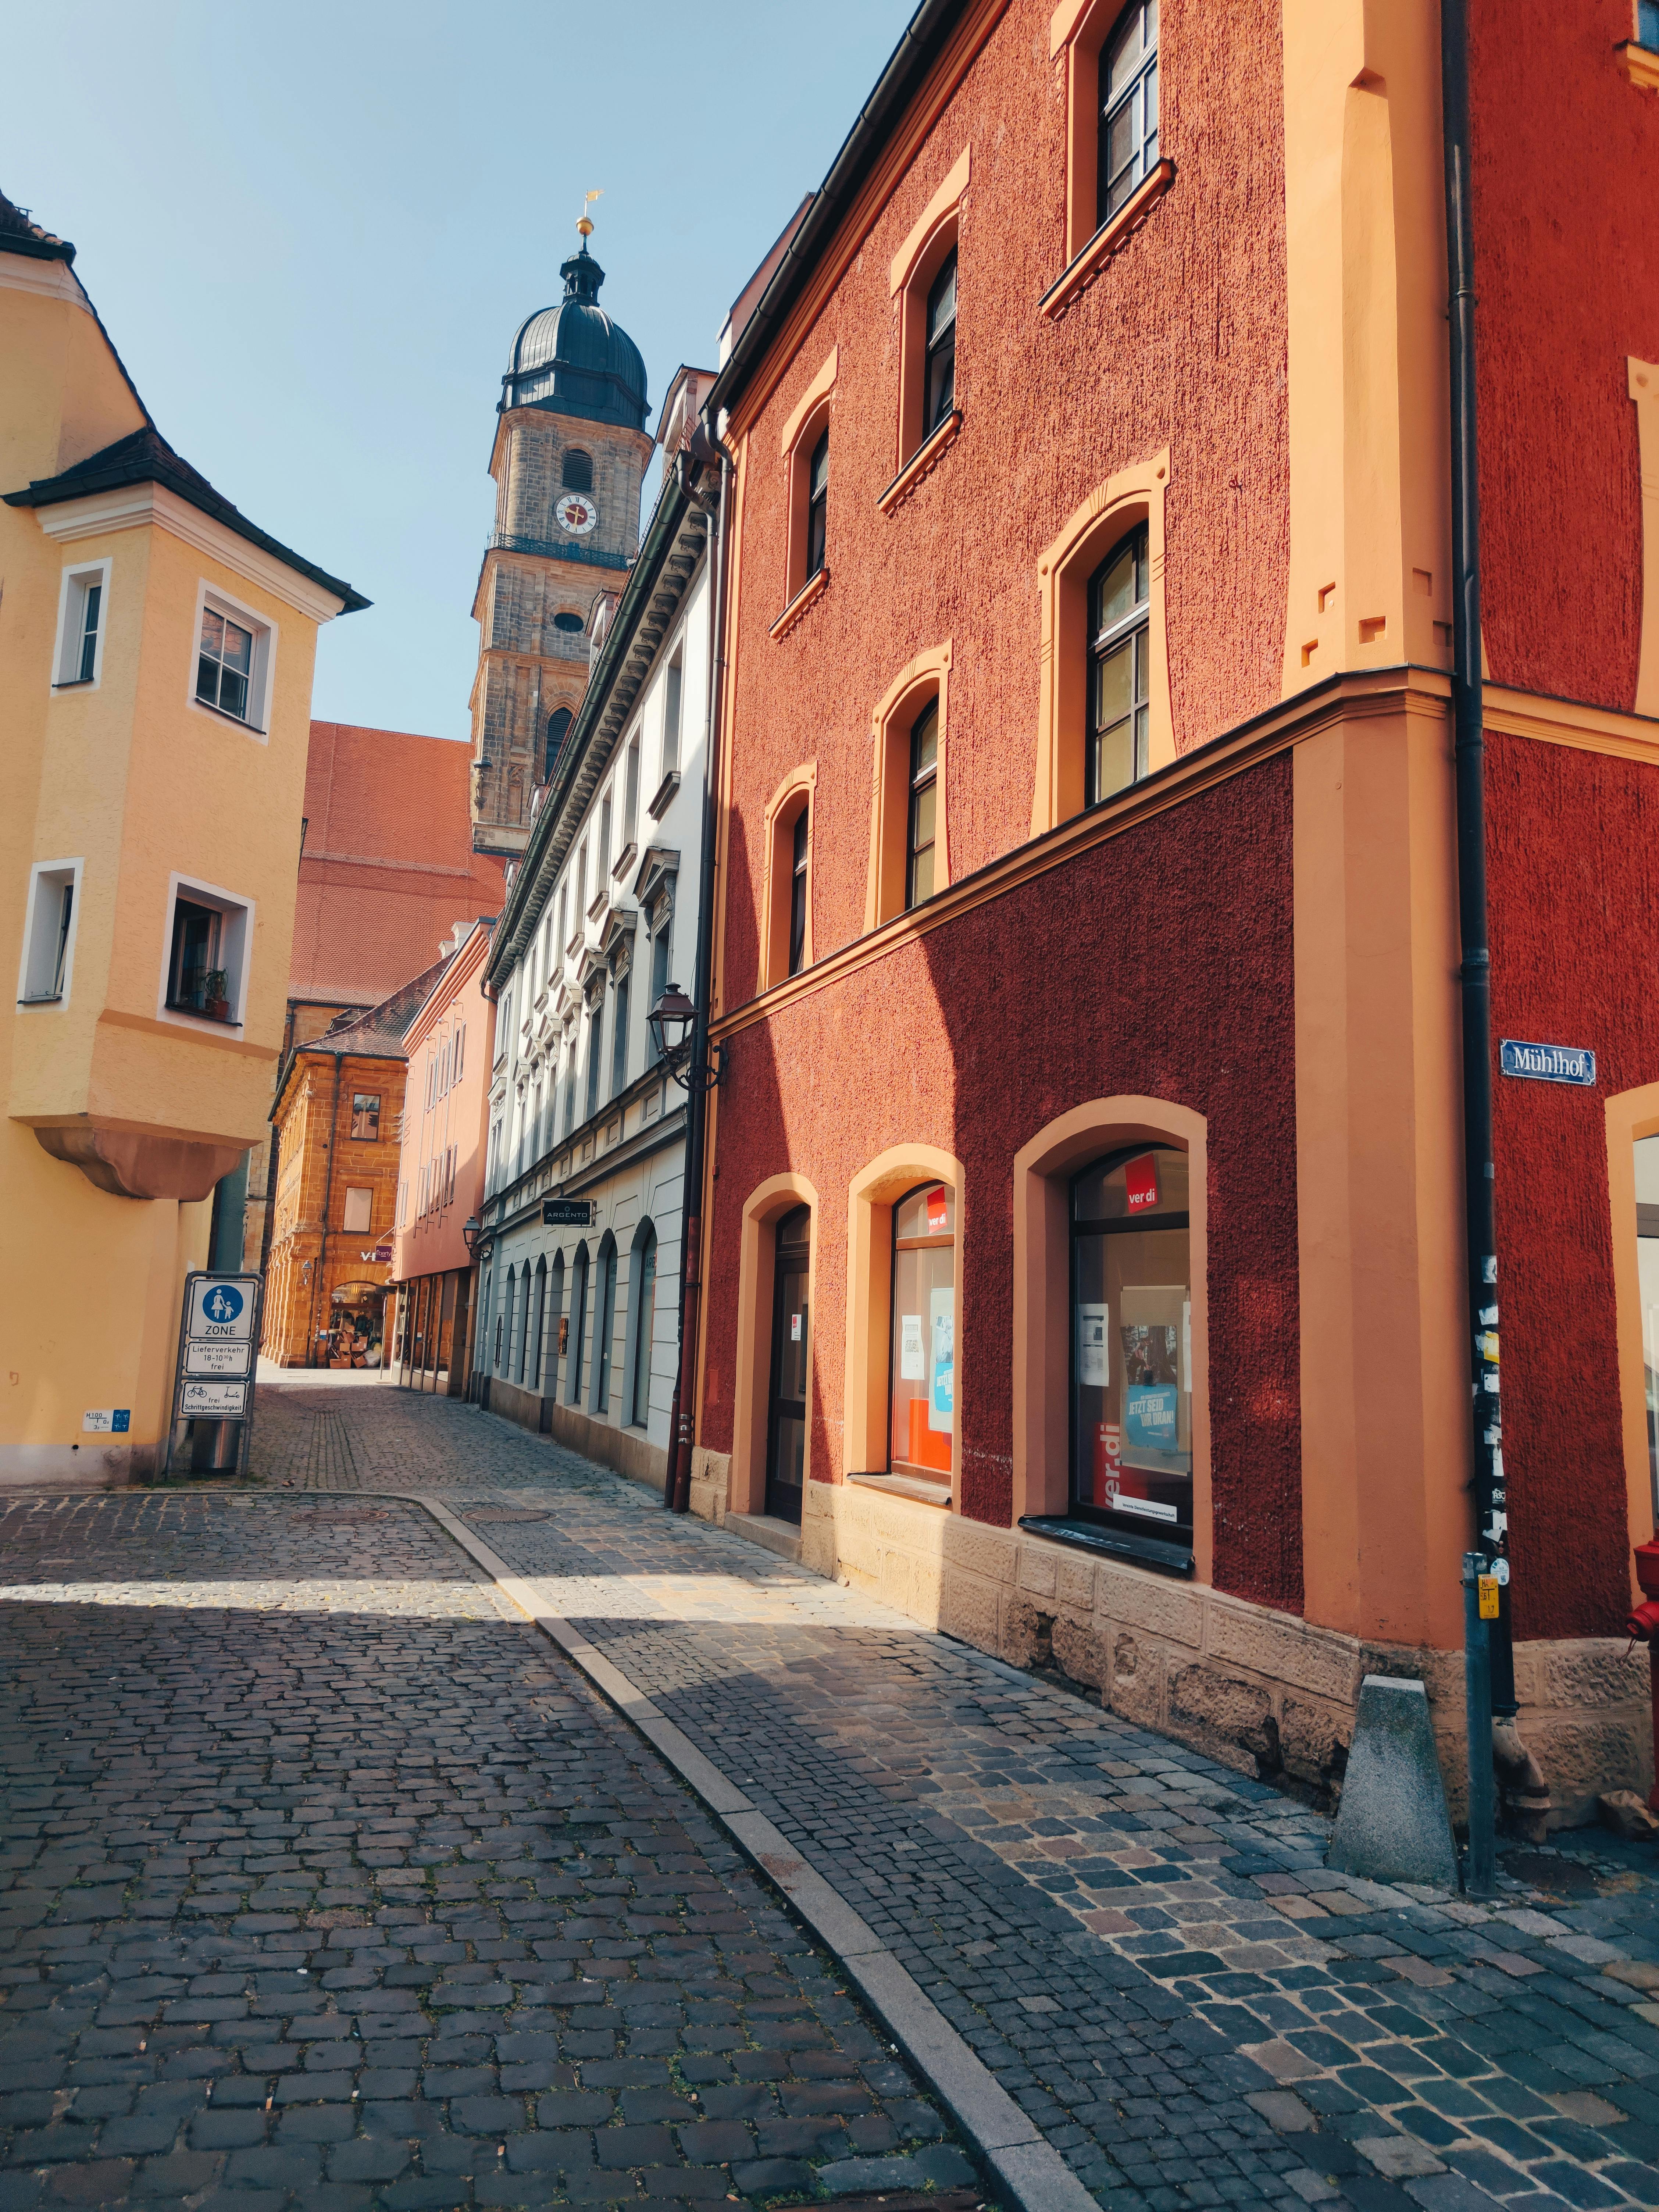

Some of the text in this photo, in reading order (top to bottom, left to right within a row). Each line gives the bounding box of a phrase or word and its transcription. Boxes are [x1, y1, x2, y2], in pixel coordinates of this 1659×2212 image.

[1513, 1047, 1584, 1077] Mühlhof
[205, 1326, 236, 1335] ZONE
[1129, 1398, 1163, 1415] JETZT SEID
[1140, 1410, 1174, 1427] IHR DRAN!
[1134, 1505, 1175, 1518] Dienstleistungsgewerkschaft
